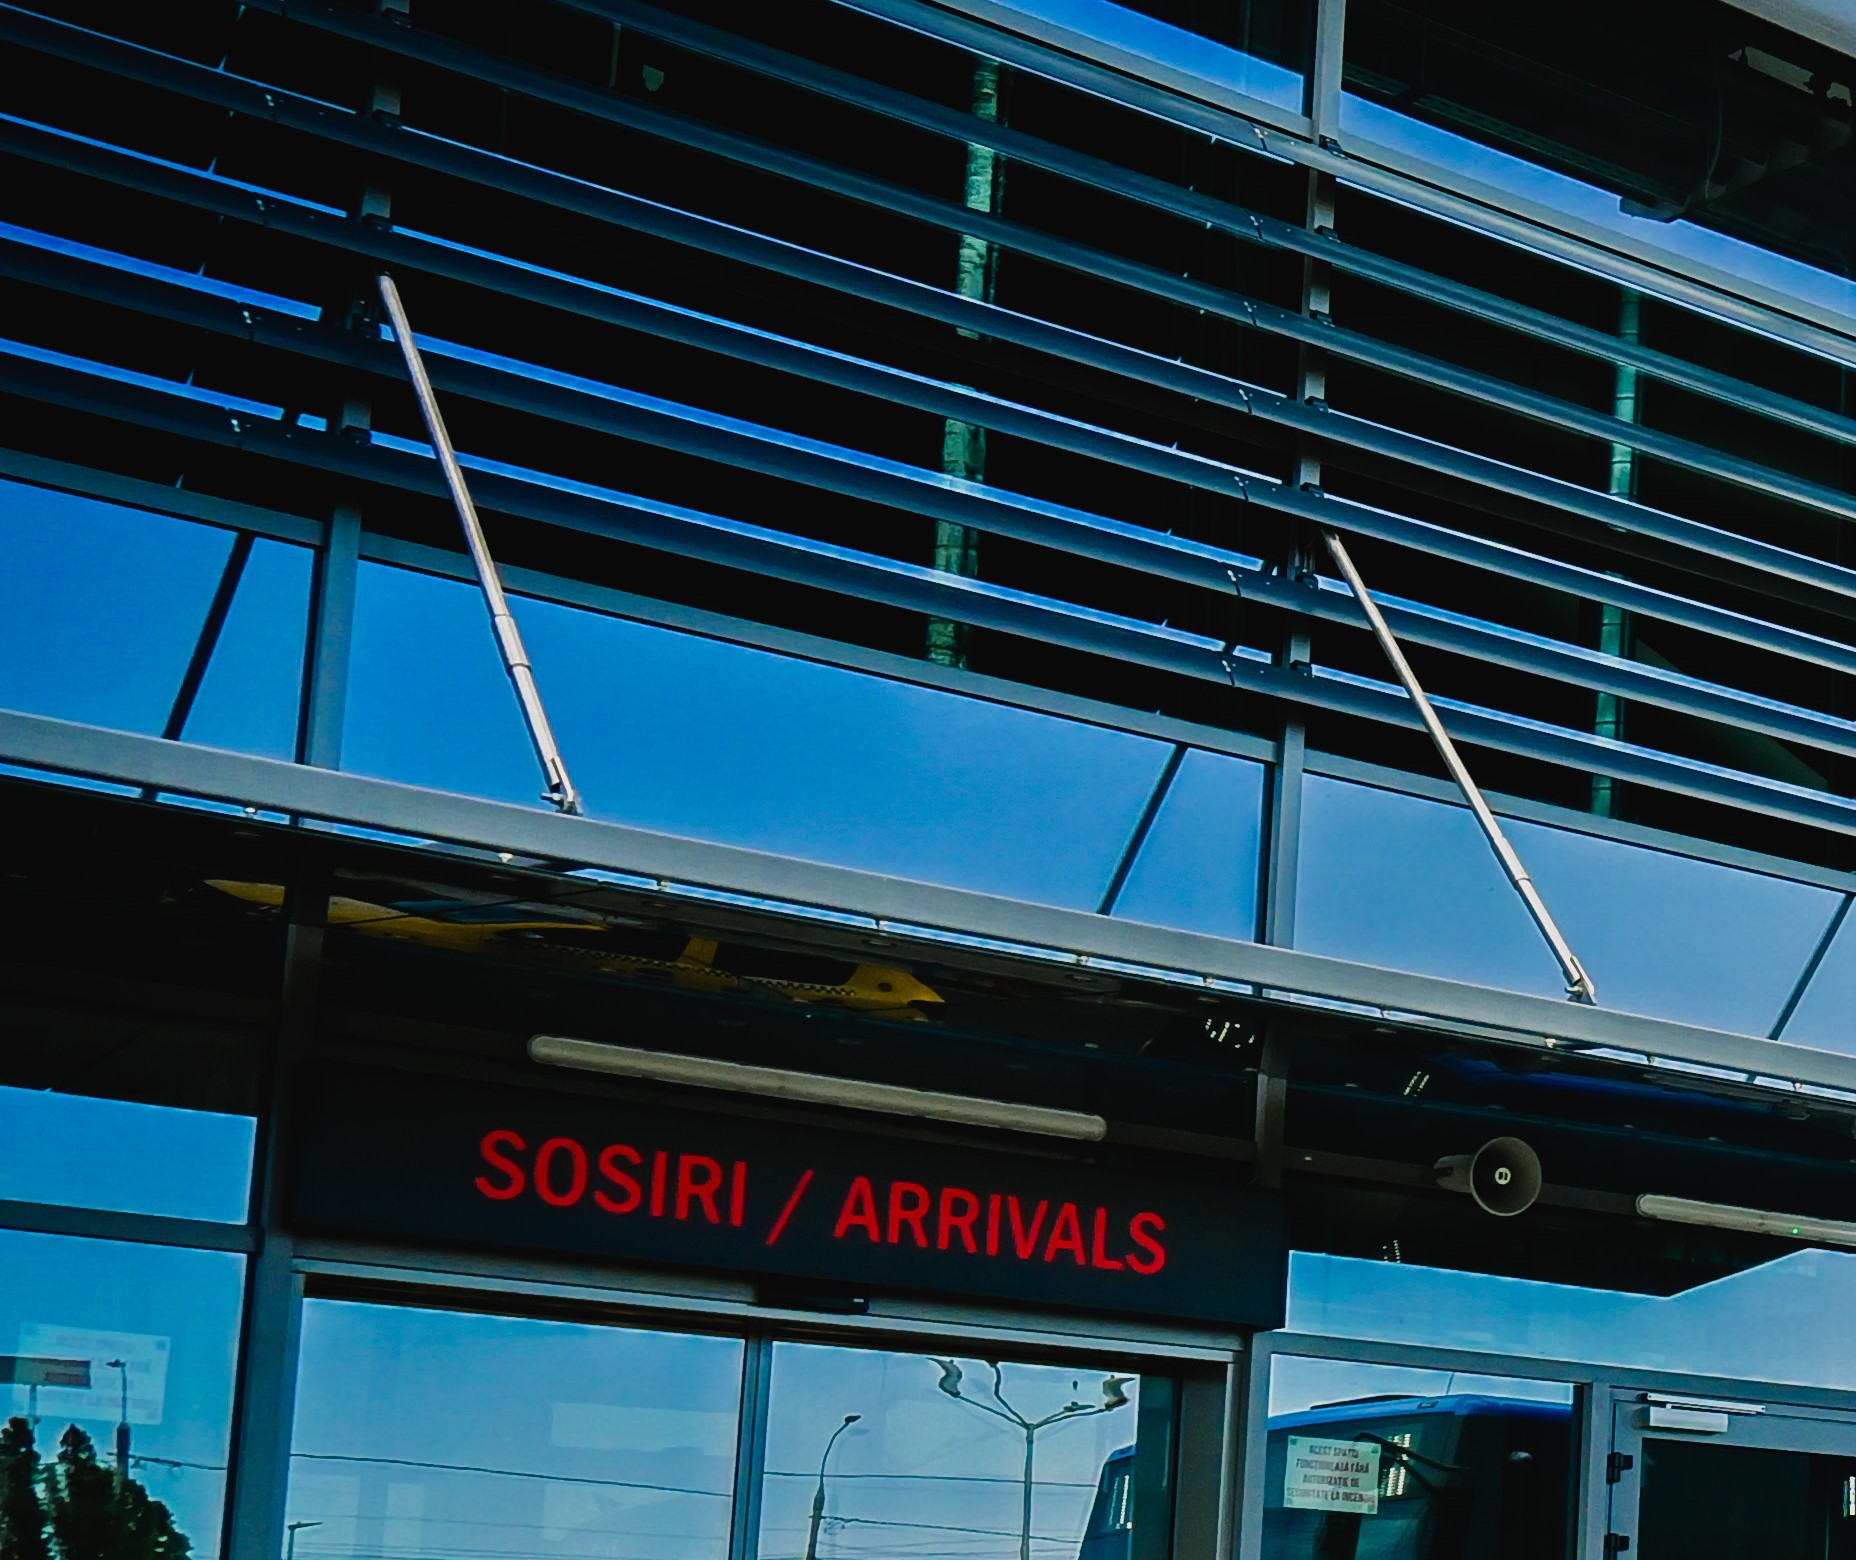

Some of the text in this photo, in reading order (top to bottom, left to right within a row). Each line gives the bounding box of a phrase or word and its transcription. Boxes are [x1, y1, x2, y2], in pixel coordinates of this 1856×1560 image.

[475, 1129, 1166, 1276] SOSIRI / ARRIVALS
